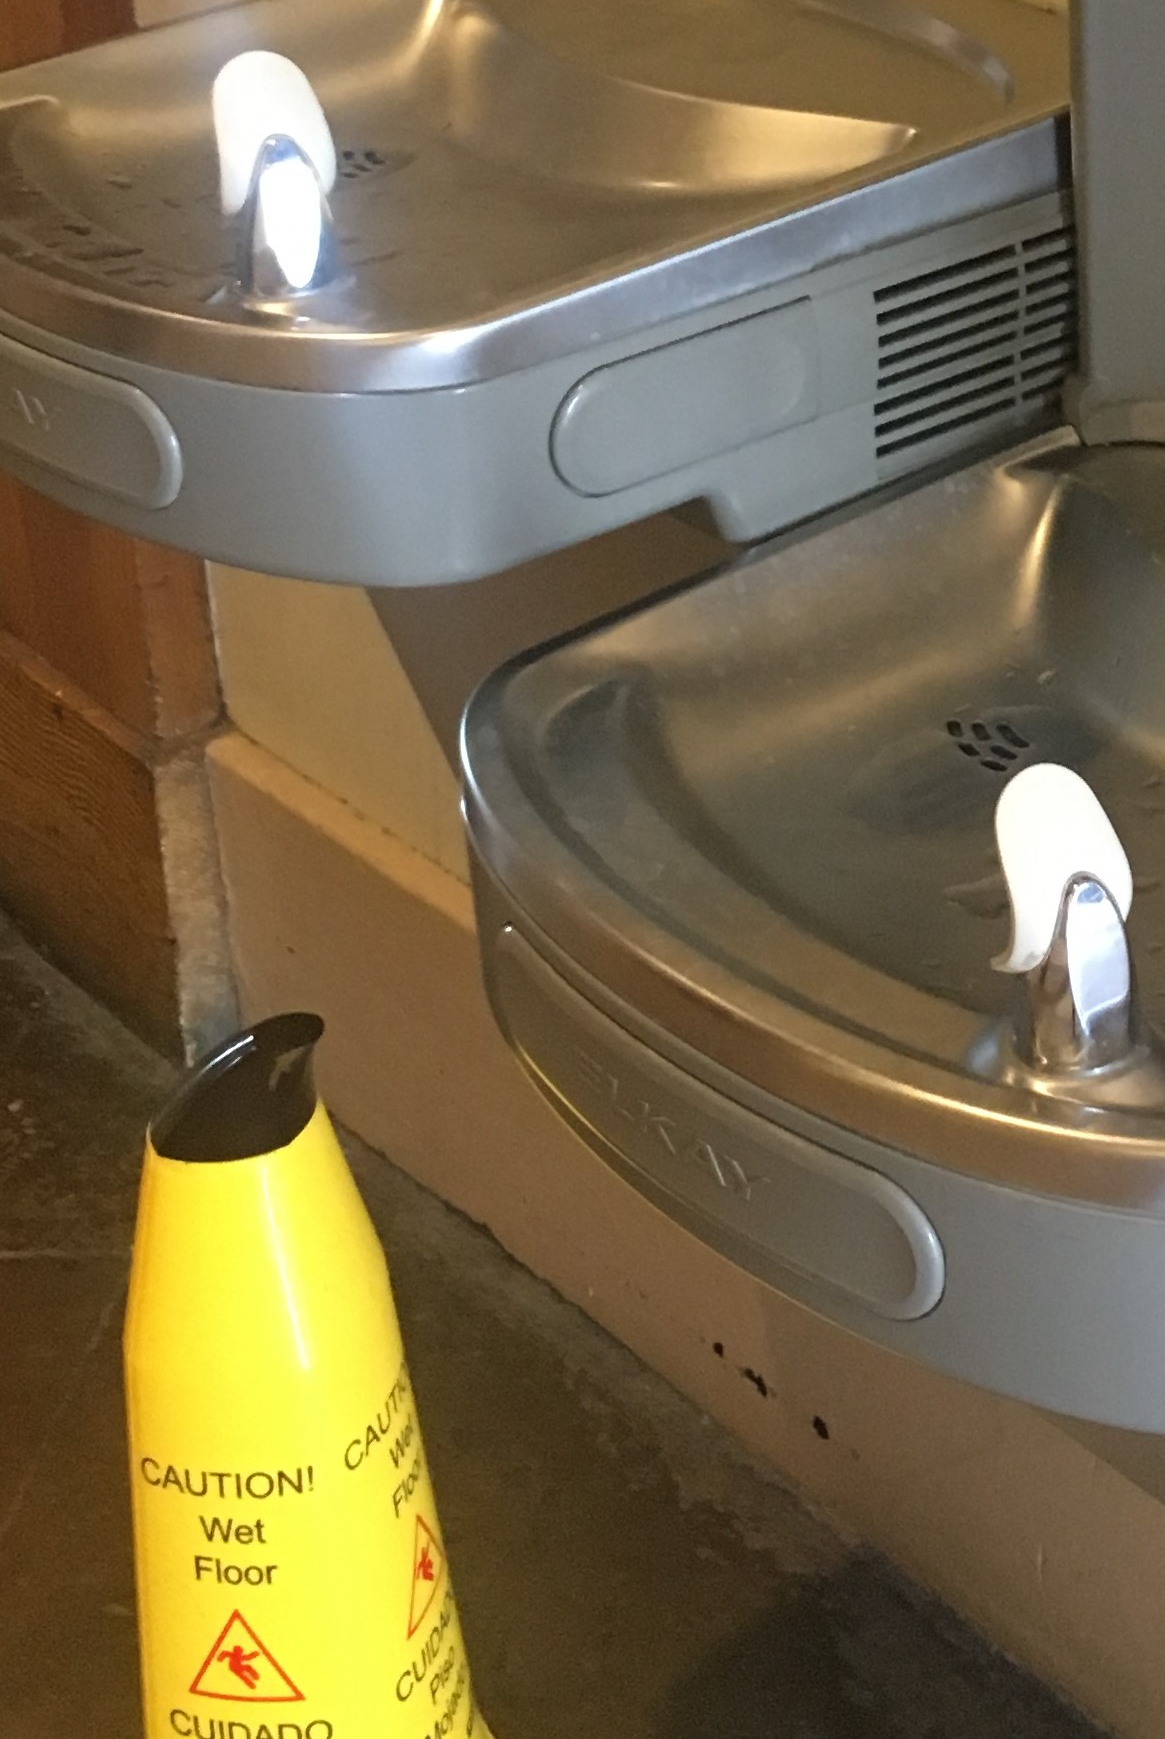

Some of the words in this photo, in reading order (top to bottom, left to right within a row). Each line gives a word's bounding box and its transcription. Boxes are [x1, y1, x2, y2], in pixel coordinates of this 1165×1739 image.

[141, 1457, 314, 1500] CAUTION!
[198, 1515, 267, 1545] Wet
[194, 1555, 278, 1586] Floor
[170, 1708, 333, 1739] CUIDADO
